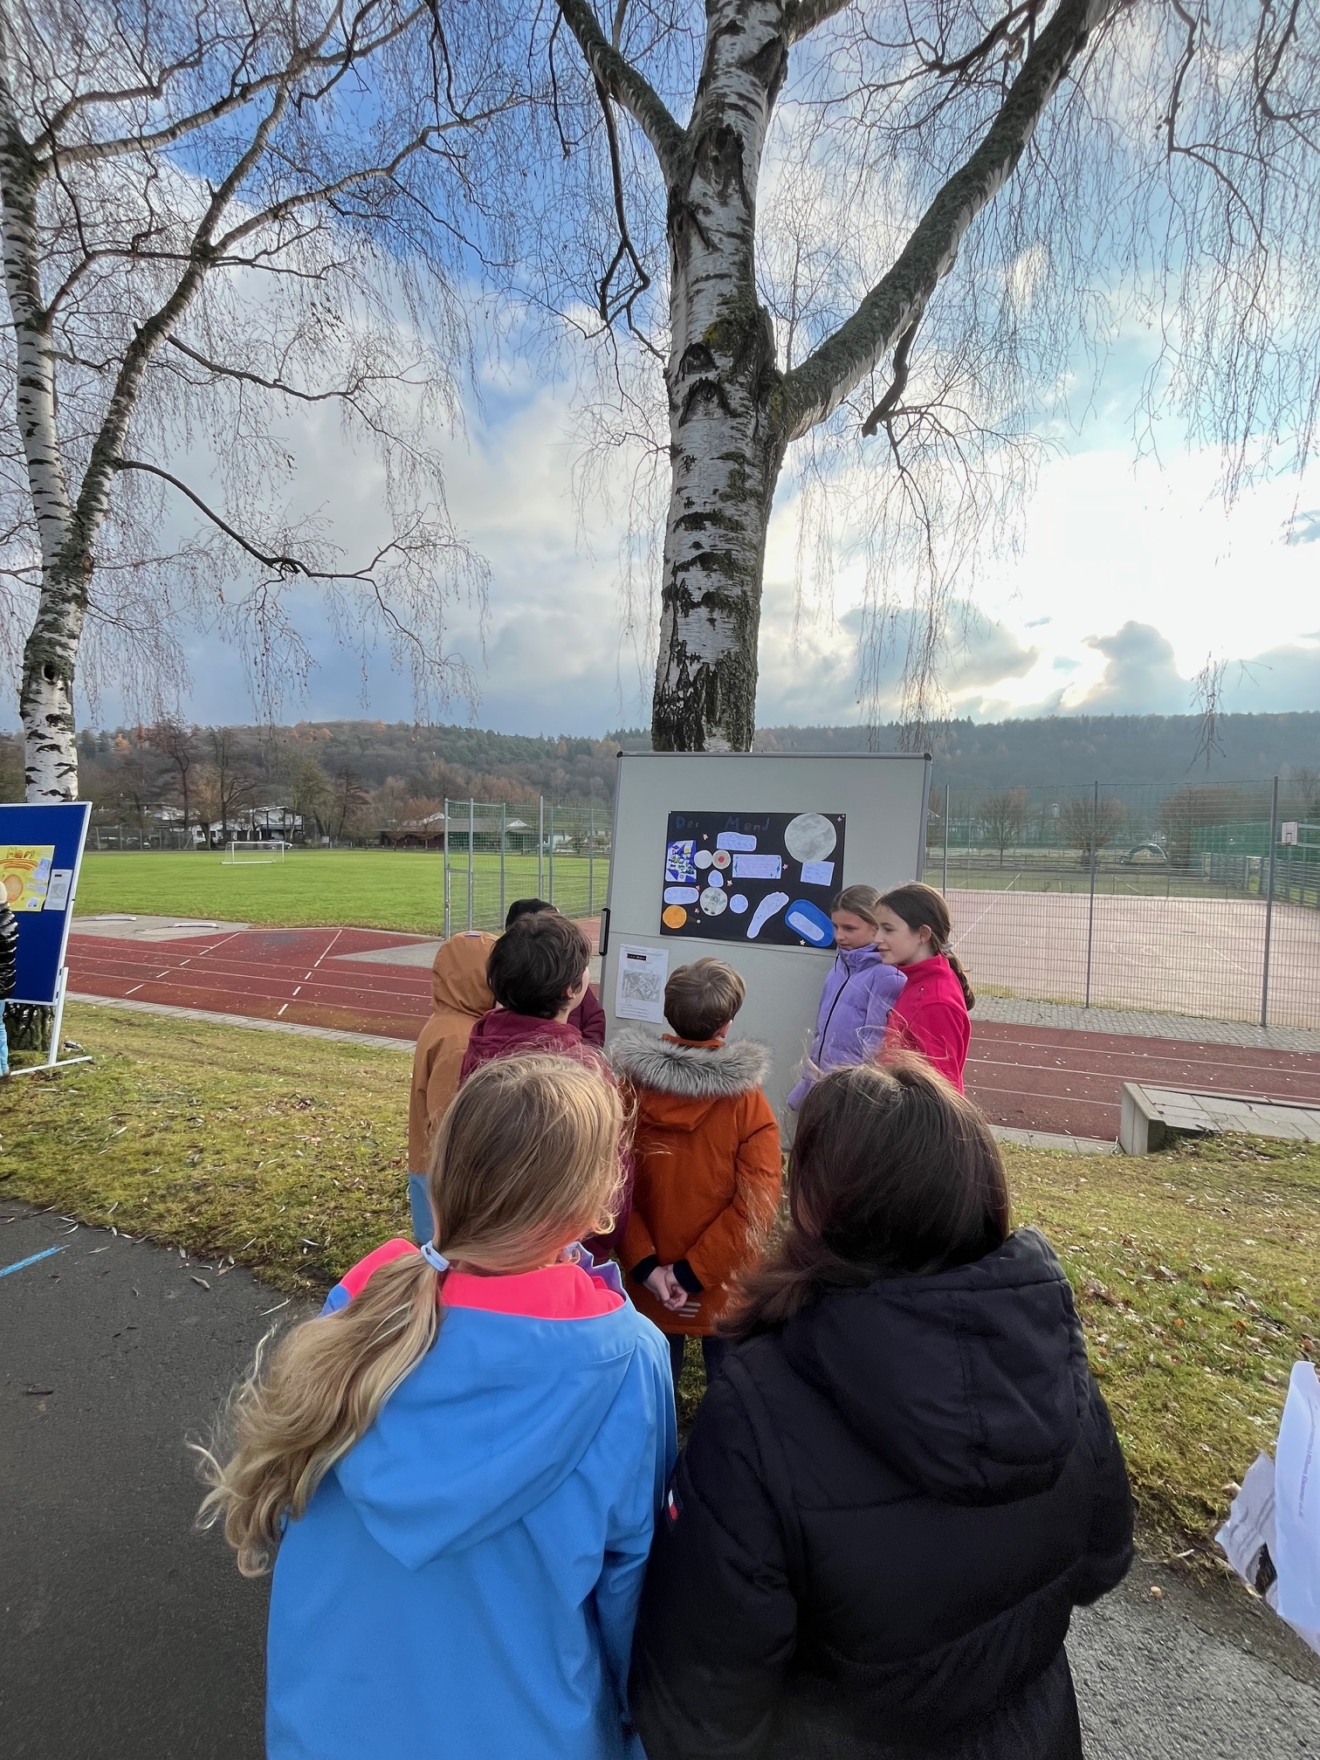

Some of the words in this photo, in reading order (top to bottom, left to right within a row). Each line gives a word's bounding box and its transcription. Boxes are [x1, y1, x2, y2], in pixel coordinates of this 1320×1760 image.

[675, 815, 700, 829] Der
[724, 816, 770, 831] Mond
[7, 847, 35, 859] Mars
